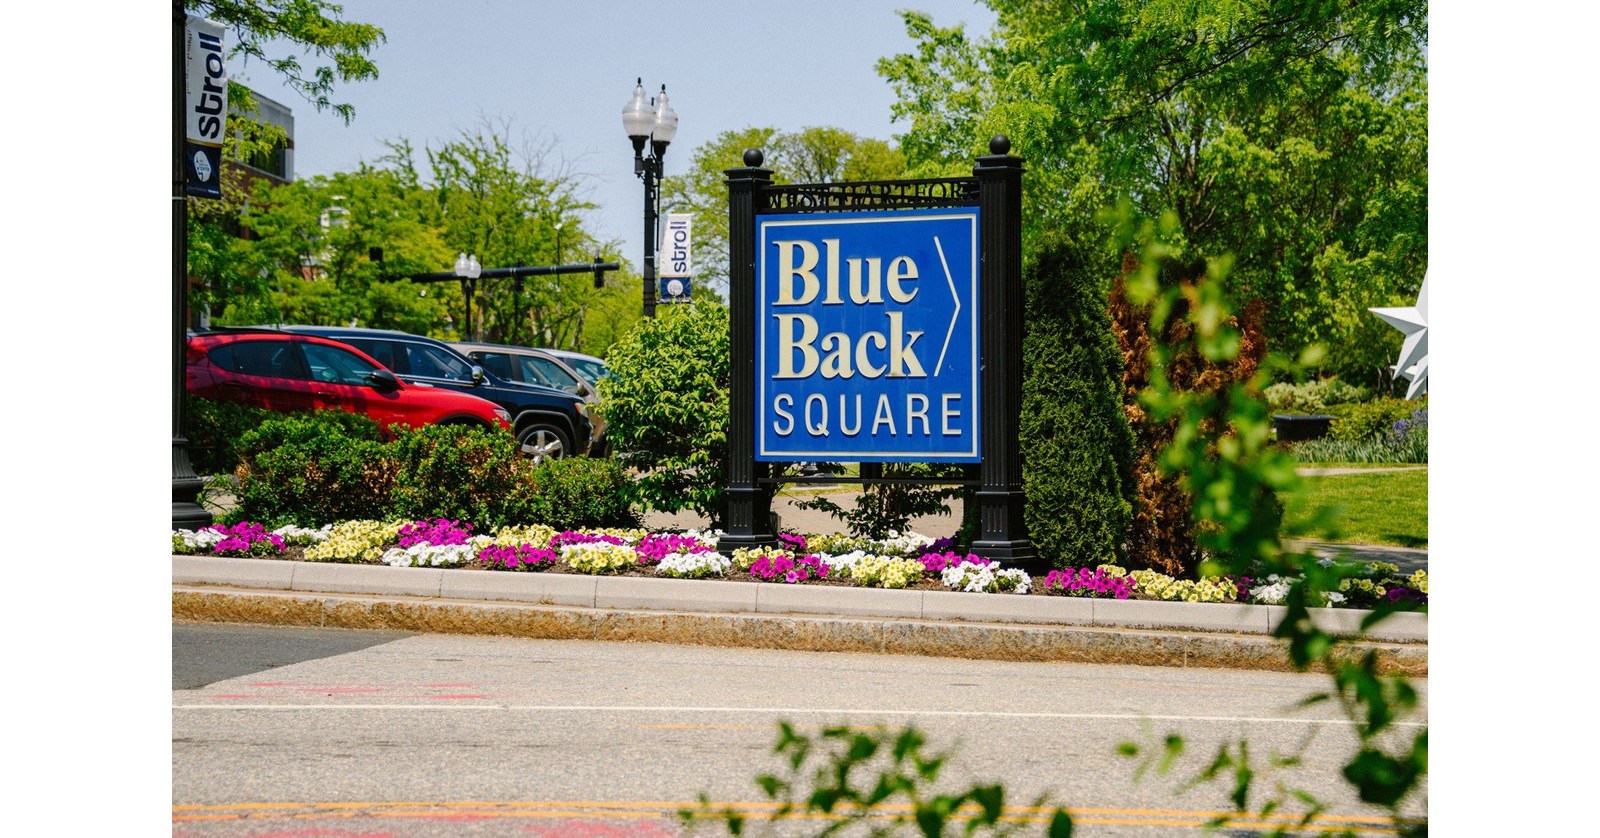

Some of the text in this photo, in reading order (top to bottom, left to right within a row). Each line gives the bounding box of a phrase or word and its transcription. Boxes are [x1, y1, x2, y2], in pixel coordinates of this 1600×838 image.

[195, 32, 223, 139] stroll
[840, 182, 975, 206] HARTFOR
[670, 221, 687, 273] stroll
[772, 239, 919, 305] Blue
[772, 311, 928, 379] Back
[773, 393, 963, 437] SQUARE
